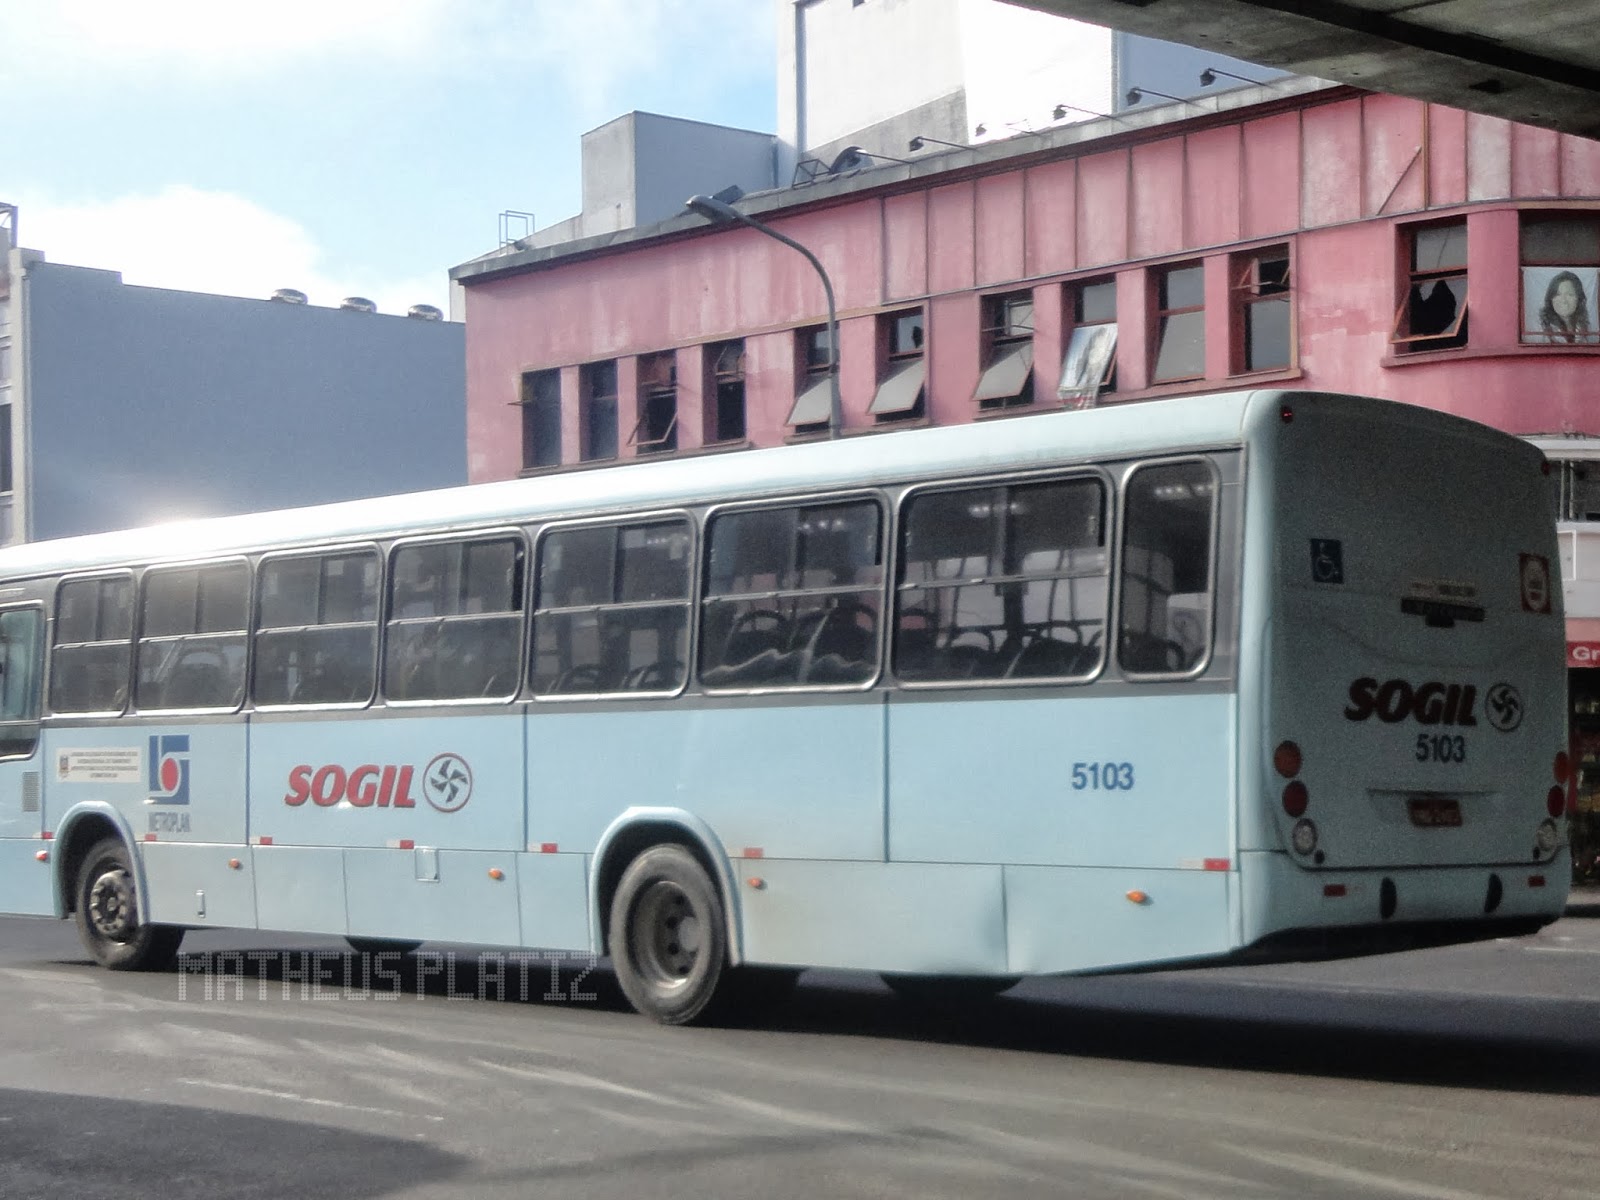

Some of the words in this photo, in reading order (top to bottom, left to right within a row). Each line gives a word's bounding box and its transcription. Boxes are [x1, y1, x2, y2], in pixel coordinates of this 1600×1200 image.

[1344, 677, 1477, 726] SOGIL
[1416, 733, 1466, 763] 5103
[284, 764, 416, 808] SOGIL
[1072, 762, 1135, 790] 5103
